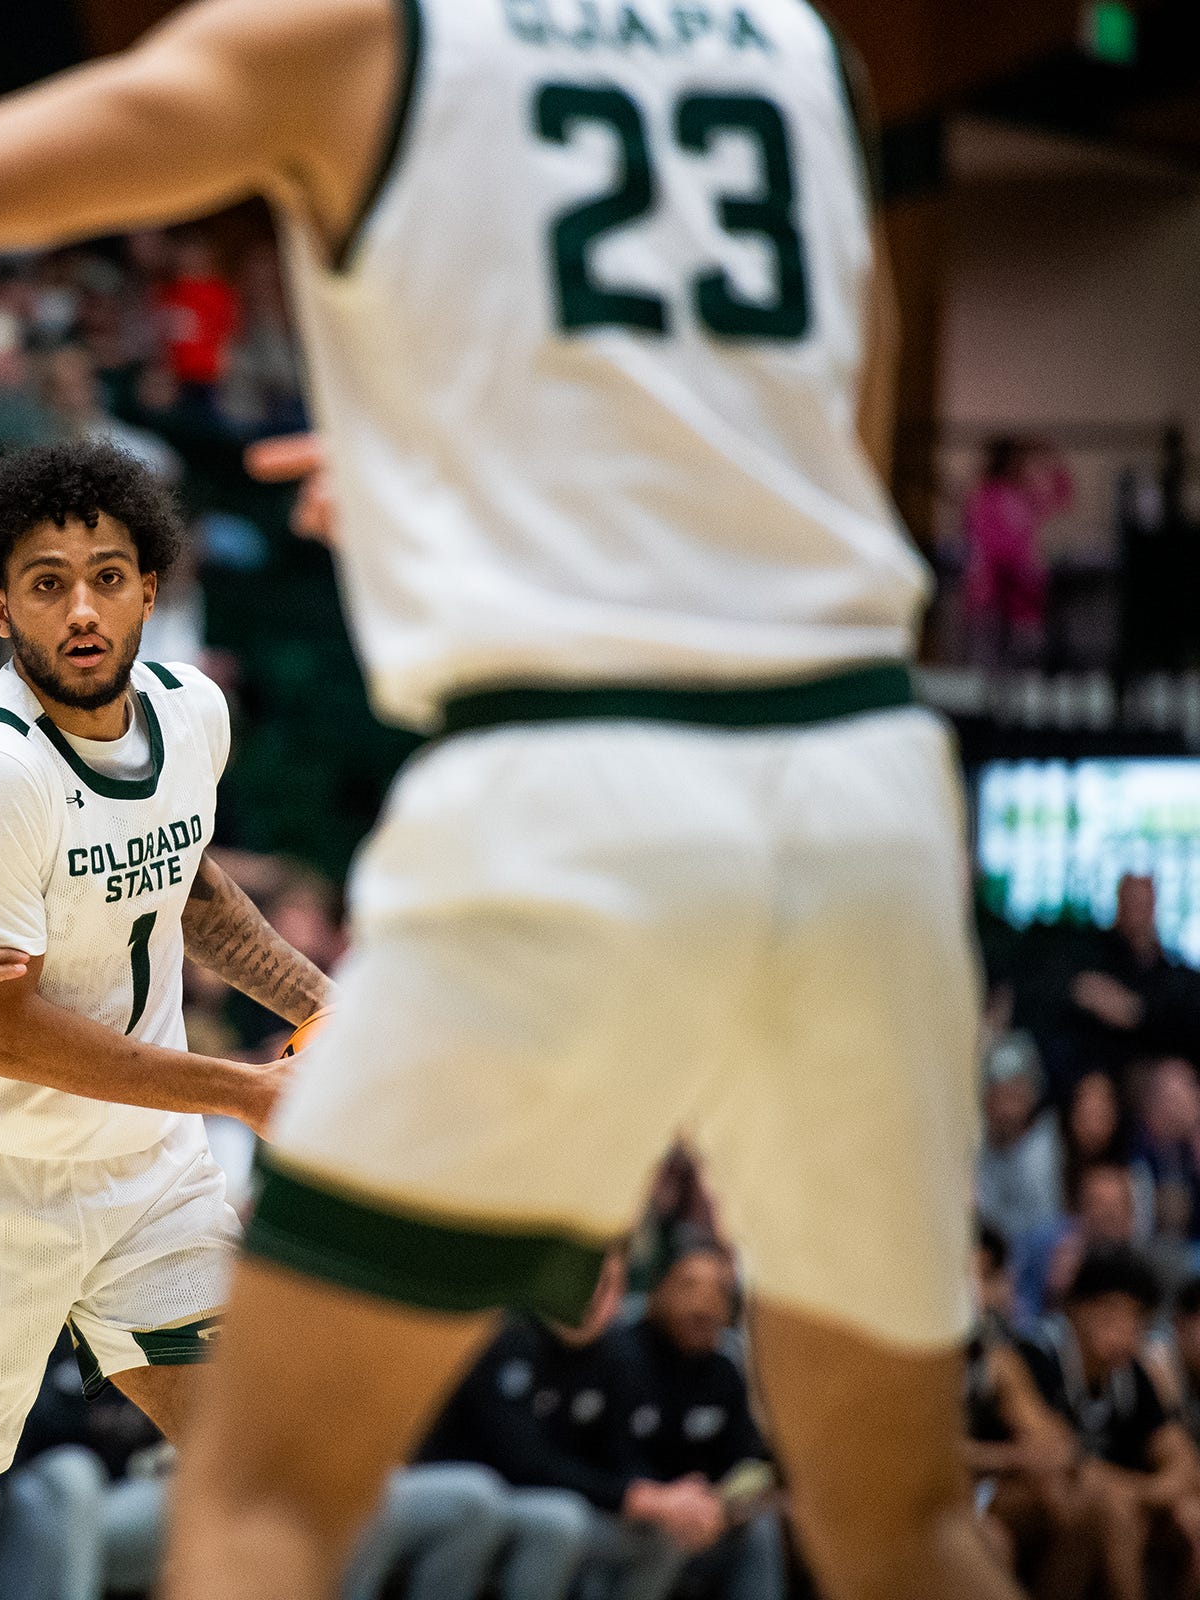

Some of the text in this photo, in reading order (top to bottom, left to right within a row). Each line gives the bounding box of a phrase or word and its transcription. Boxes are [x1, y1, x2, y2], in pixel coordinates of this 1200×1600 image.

[532, 81, 810, 341] 23
[67, 814, 202, 877] COLORADO
[105, 855, 183, 903] STATE
[124, 910, 158, 1036] 1
